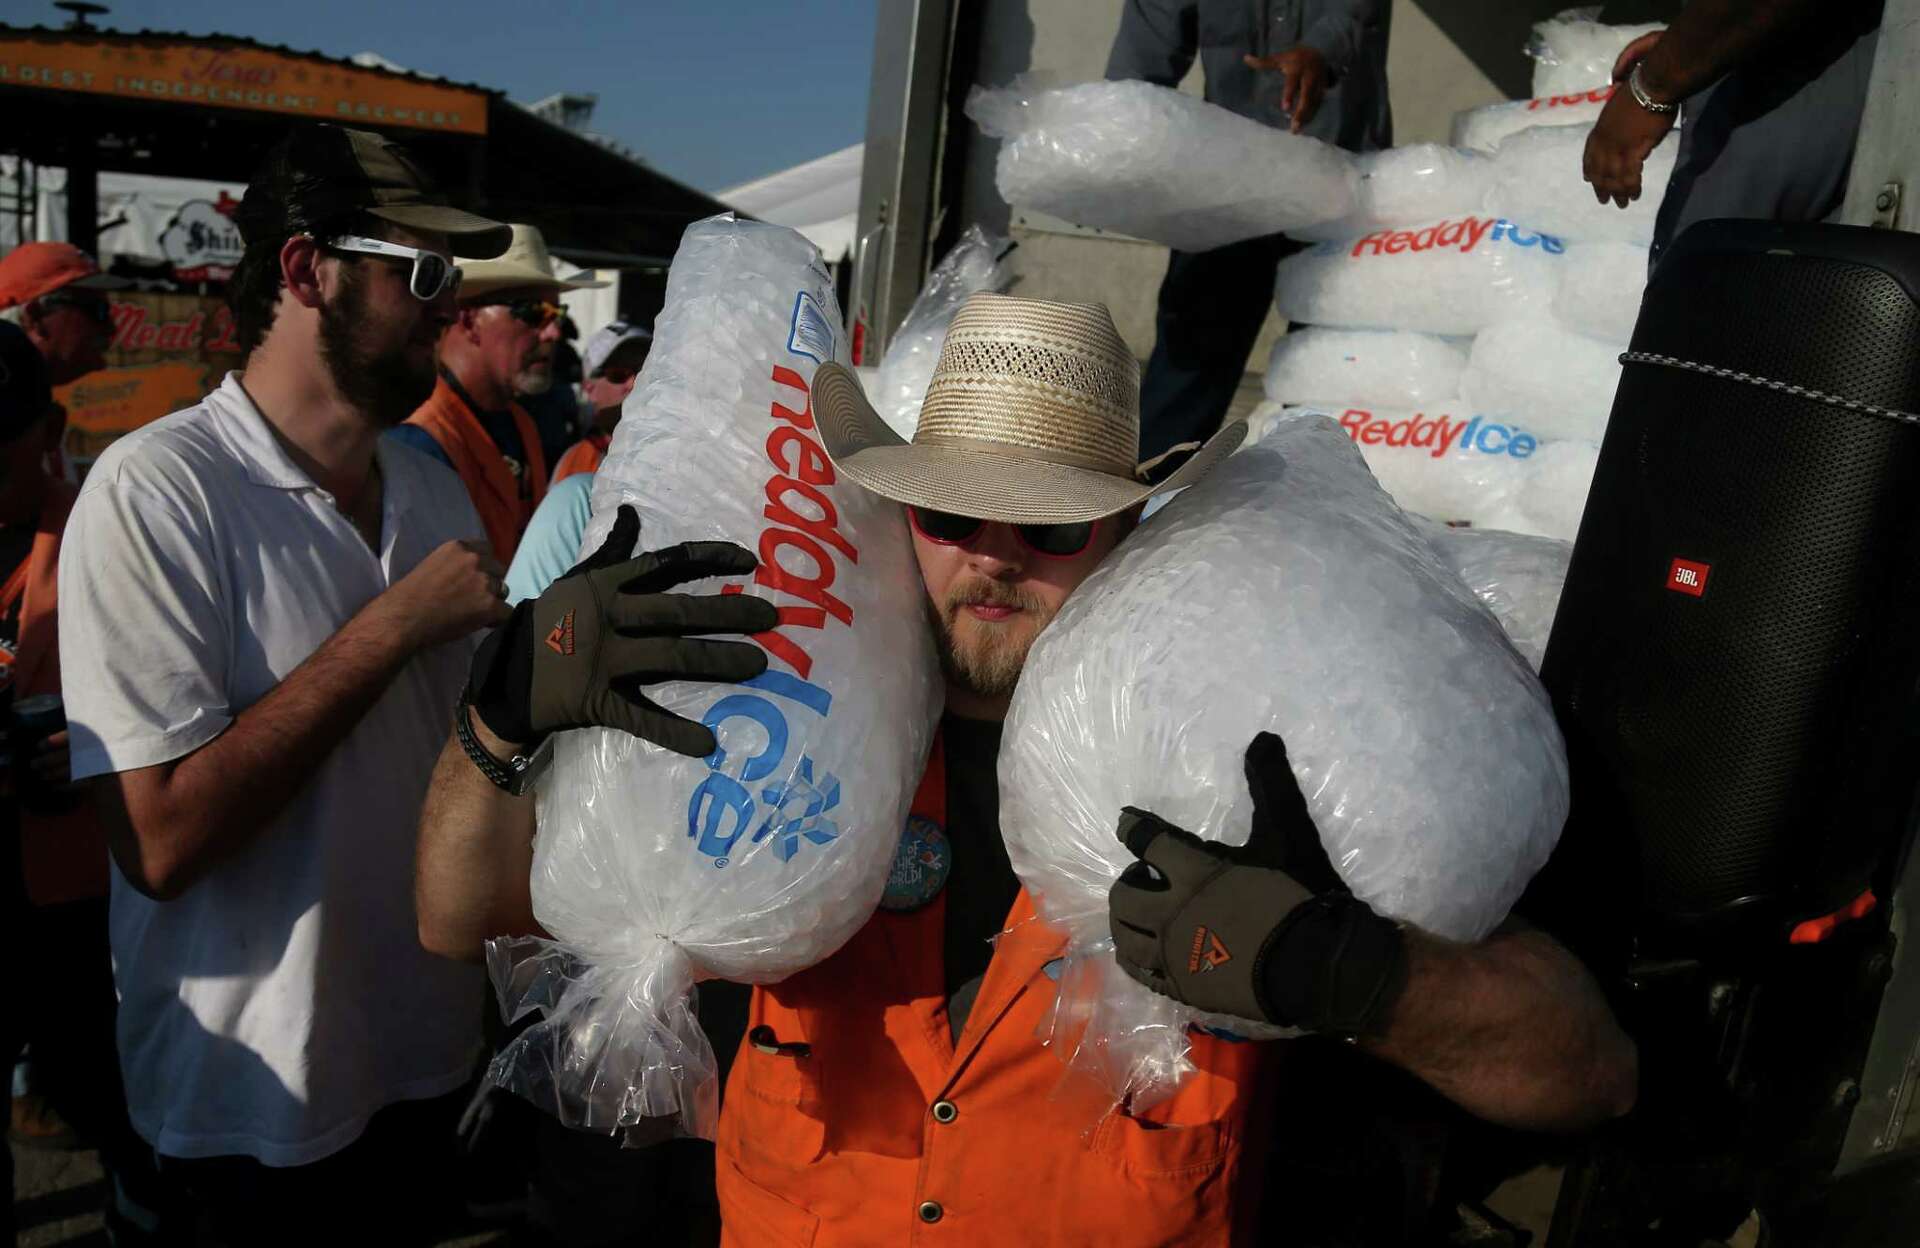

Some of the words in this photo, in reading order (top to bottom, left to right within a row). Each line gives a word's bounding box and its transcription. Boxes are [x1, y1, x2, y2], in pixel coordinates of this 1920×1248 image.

[115, 75, 319, 110] INDEPENDENT
[110, 302, 202, 349] Meat
[1675, 567, 1698, 587] JBL
